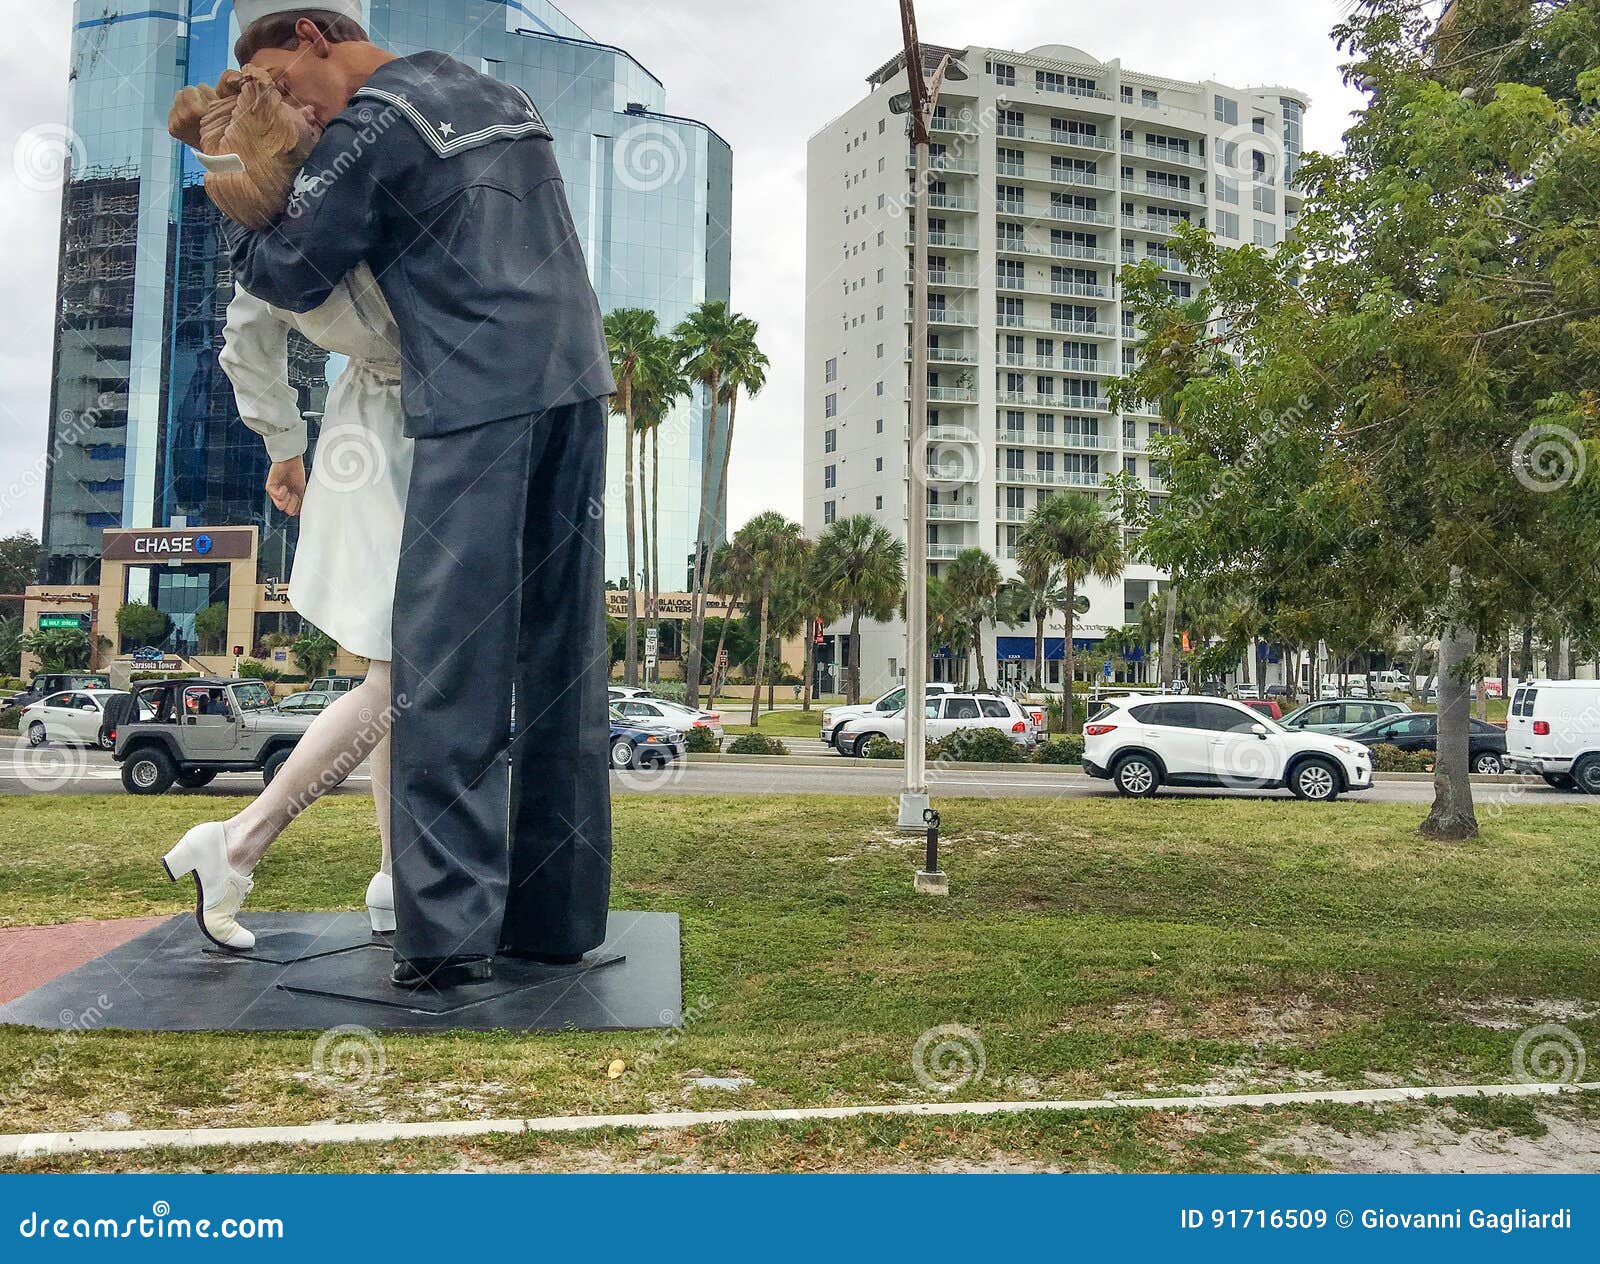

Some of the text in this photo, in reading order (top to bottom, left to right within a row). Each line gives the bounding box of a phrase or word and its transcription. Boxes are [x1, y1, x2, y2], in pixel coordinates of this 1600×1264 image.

[134, 537, 193, 553] CHASE
[659, 598, 692, 606] BLALOCK
[659, 605, 692, 613] WALTERS
[131, 661, 176, 669] Sarasota Tower
